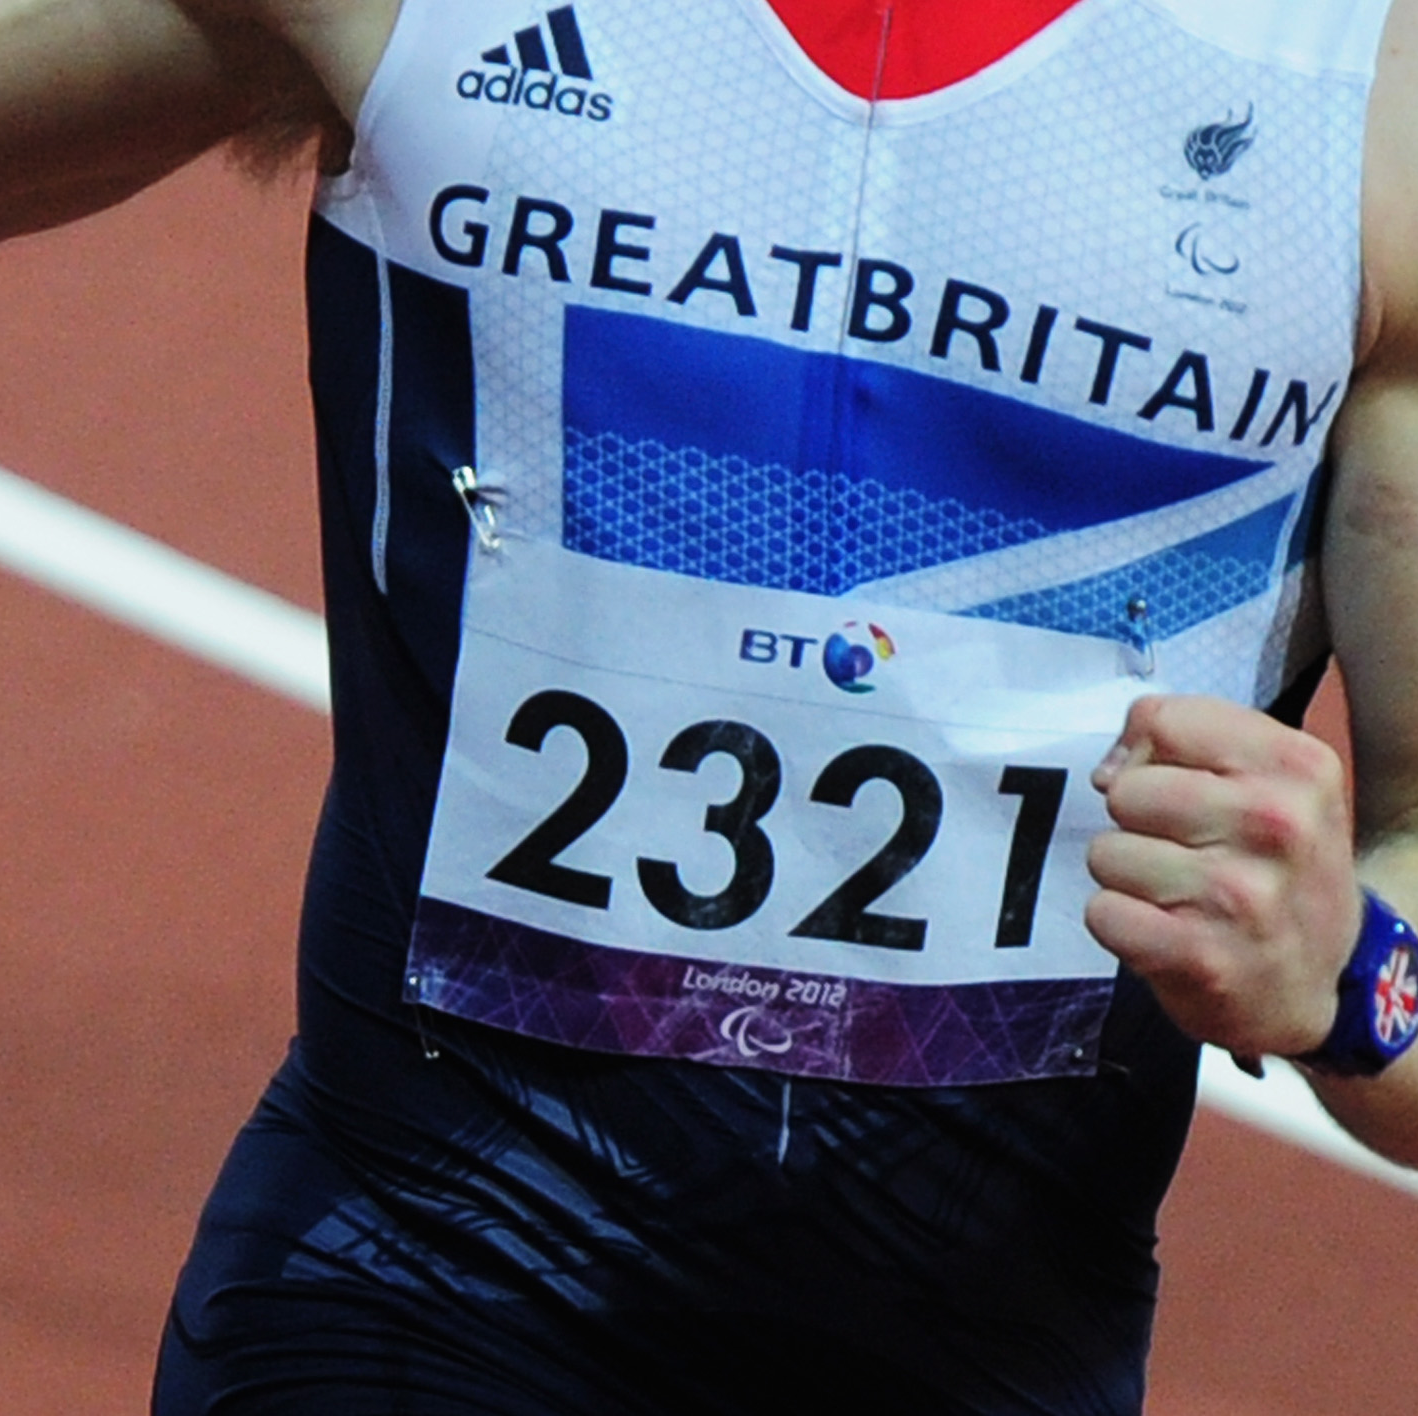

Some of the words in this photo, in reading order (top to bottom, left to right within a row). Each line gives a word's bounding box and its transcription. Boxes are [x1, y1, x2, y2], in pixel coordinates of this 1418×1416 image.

[456, 64, 613, 122] adidas
[739, 628, 817, 668] BT
[485, 689, 1068, 951] 2321
[682, 965, 781, 1000] London
[785, 978, 847, 1008] 2012
